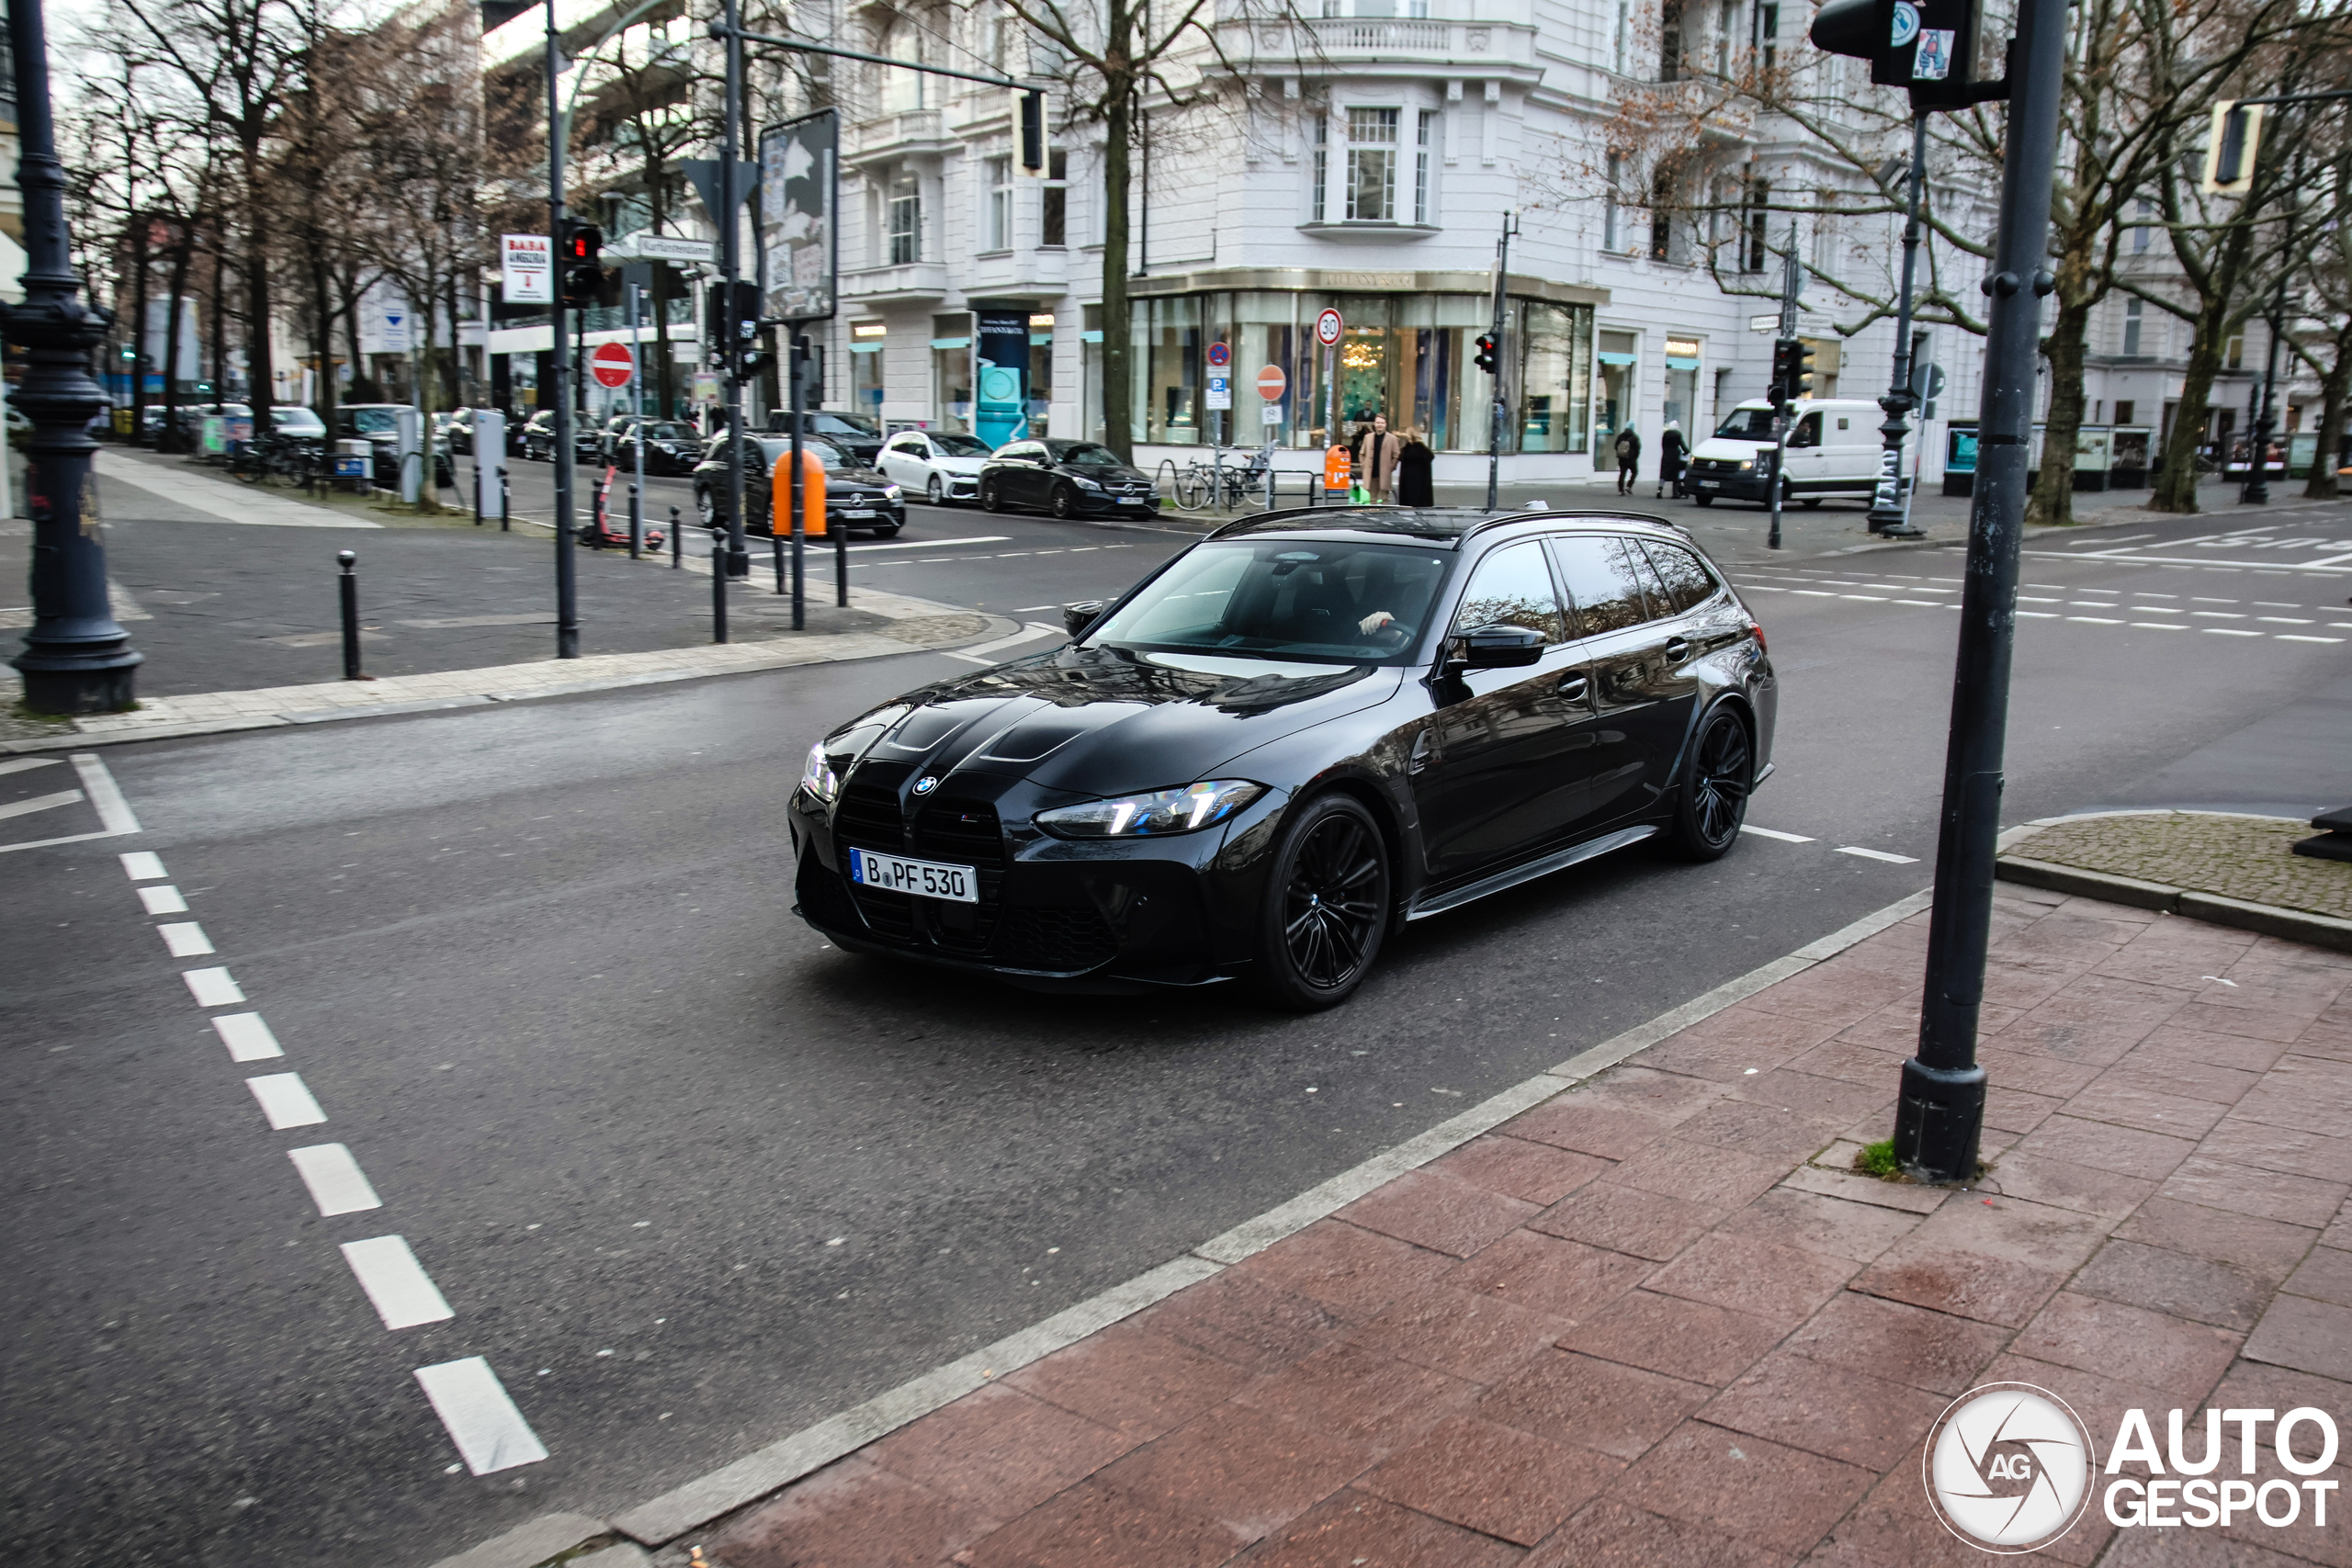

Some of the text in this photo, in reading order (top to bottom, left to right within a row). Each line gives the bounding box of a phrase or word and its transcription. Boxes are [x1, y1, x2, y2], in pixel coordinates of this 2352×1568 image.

[1322, 319, 1338, 335] 30
[1213, 378, 1223, 390] P
[867, 856, 966, 897] B PF 530
